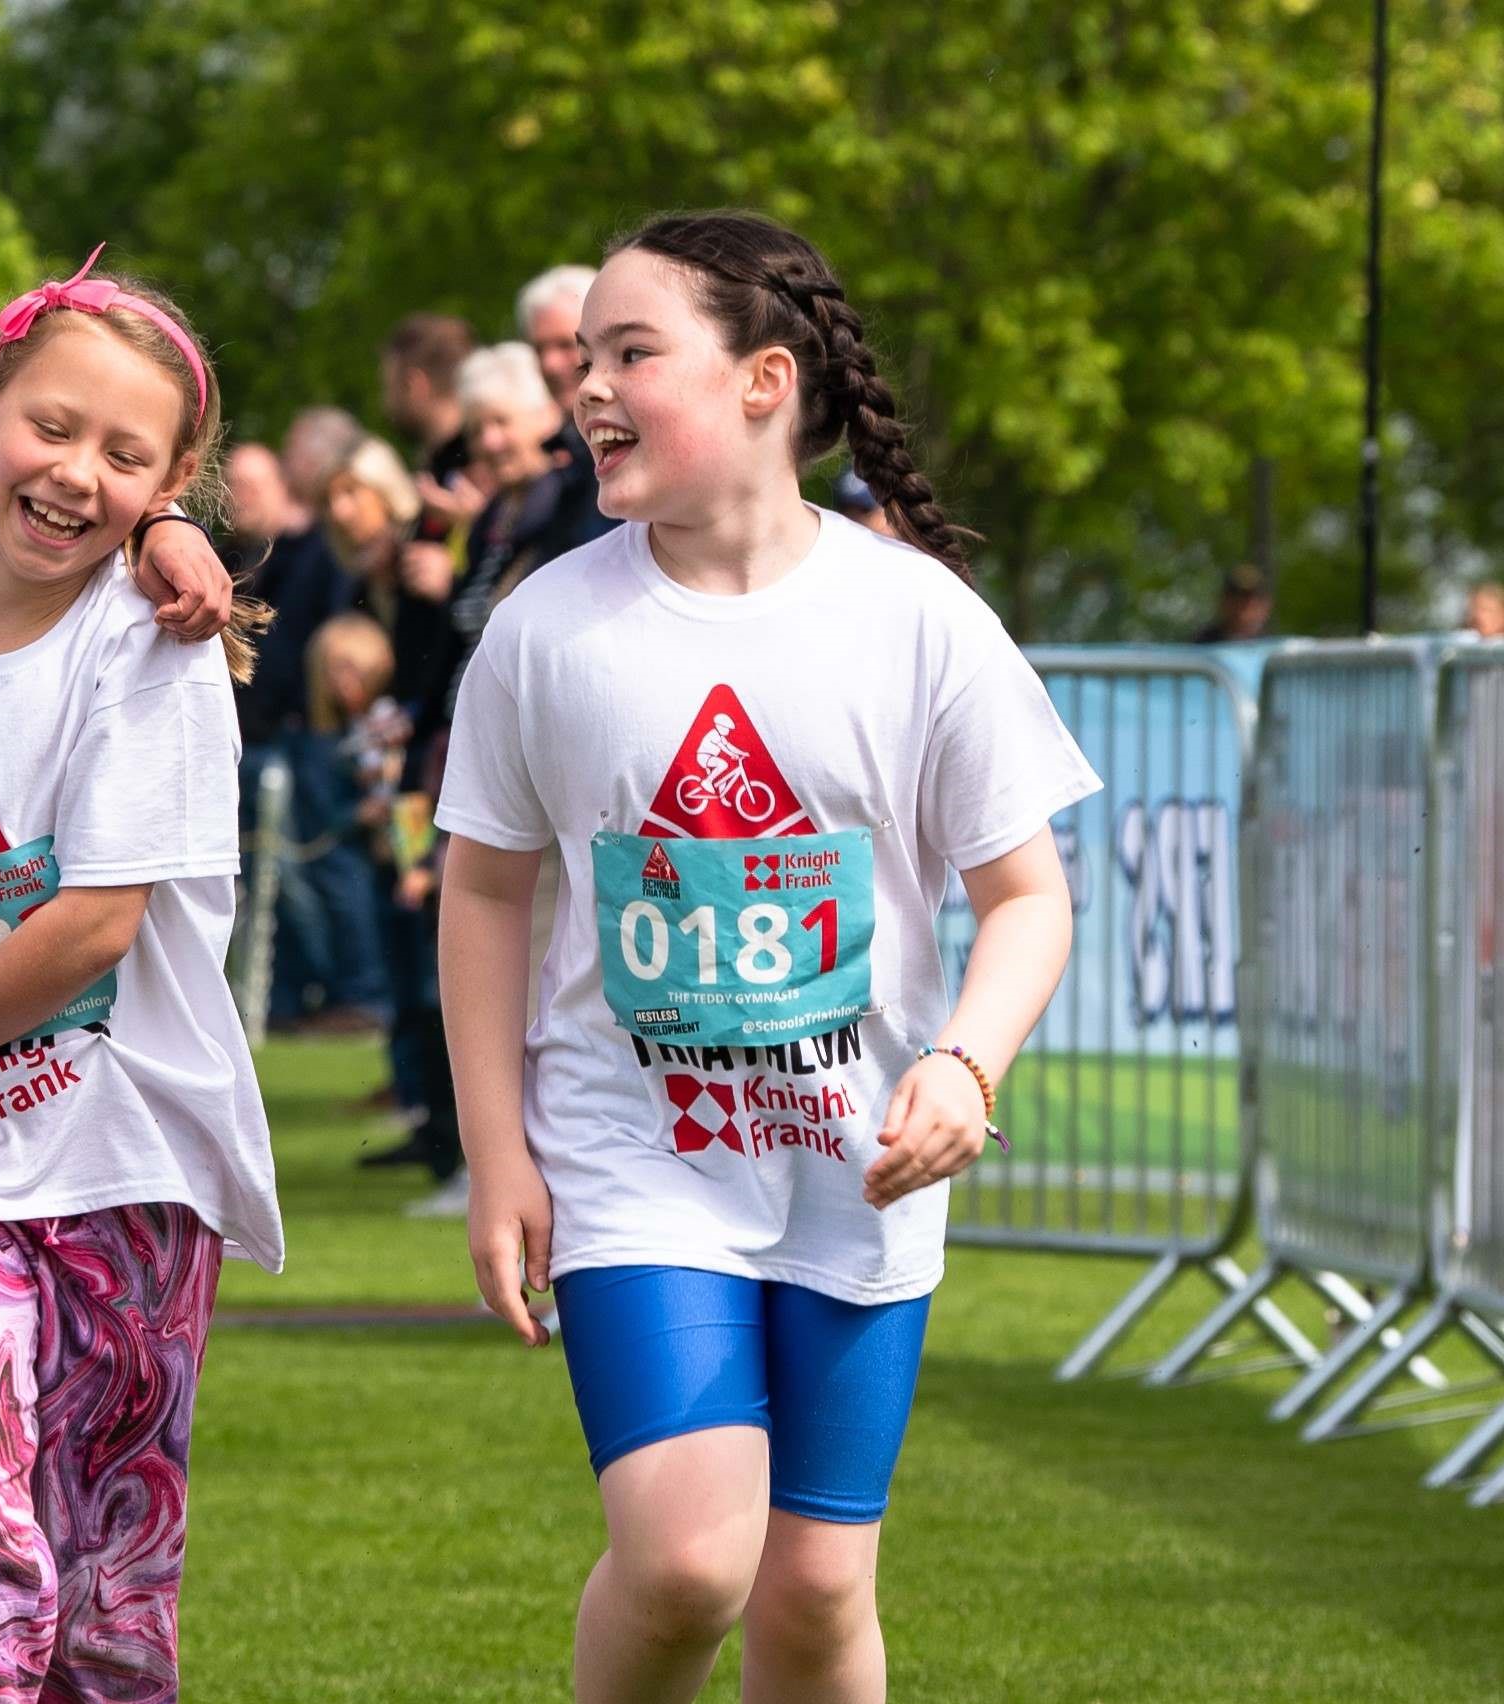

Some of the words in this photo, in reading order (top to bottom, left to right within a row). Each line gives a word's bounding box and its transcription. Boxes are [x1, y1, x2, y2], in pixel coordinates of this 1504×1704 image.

[785, 850, 840, 872] Knight
[642, 878, 680, 892] SCHOOLS
[785, 871, 832, 890] Frank
[642, 888, 681, 900] TRIATHLON
[620, 898, 838, 985] 0181
[668, 991, 689, 1003] THE
[692, 991, 732, 1005] TEDDY
[635, 1009, 679, 1022] RESTLESS
[742, 1004, 860, 1033] @SchoolsTriathlon
[744, 1075, 856, 1124] Knight
[751, 1119, 847, 1163] Frank
